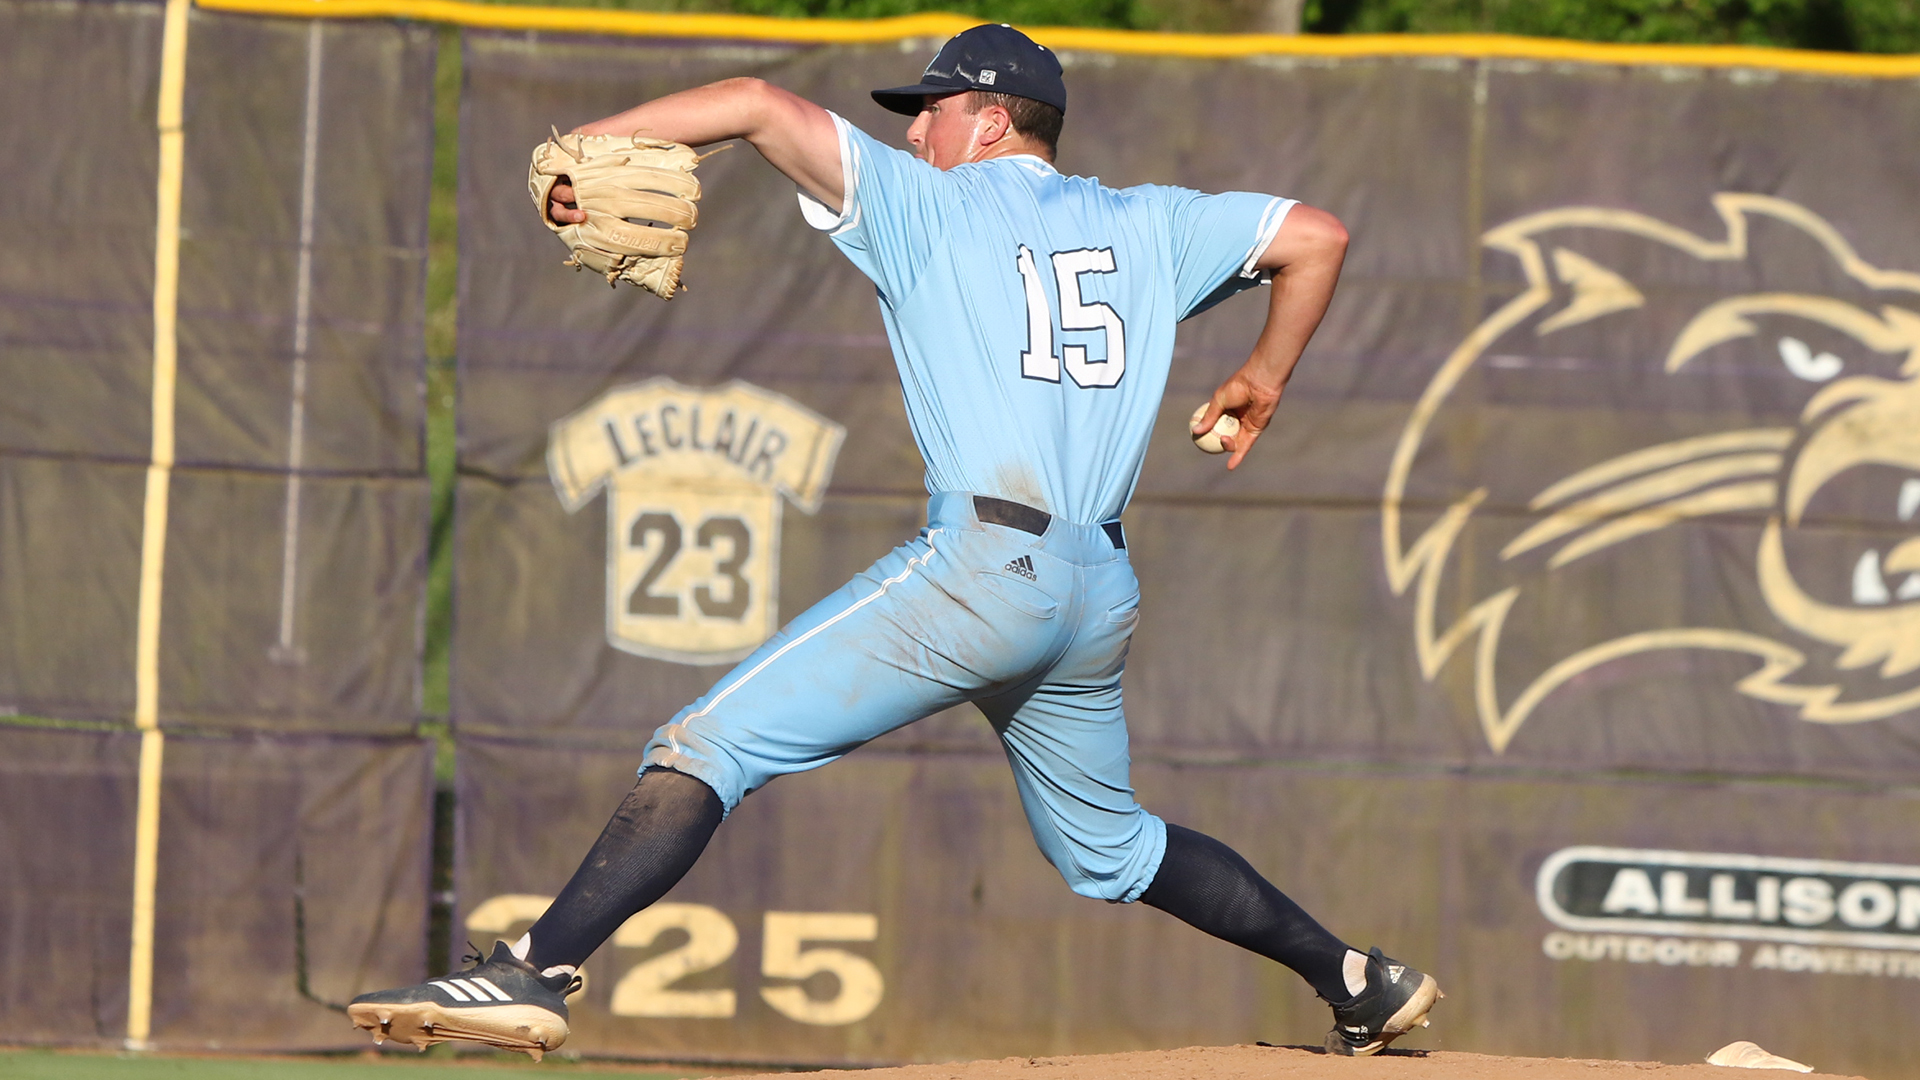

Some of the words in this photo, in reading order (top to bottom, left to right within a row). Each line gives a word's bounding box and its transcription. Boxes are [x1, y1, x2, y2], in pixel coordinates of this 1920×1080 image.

[608, 229, 661, 250] marucci
[1016, 243, 1126, 389] 15
[603, 405, 788, 482] LECLAIR
[627, 511, 751, 621] 23
[1004, 563, 1038, 582] adidas
[1542, 931, 1741, 967] OUTDOOR
[1751, 944, 1920, 979] ADVERTI
